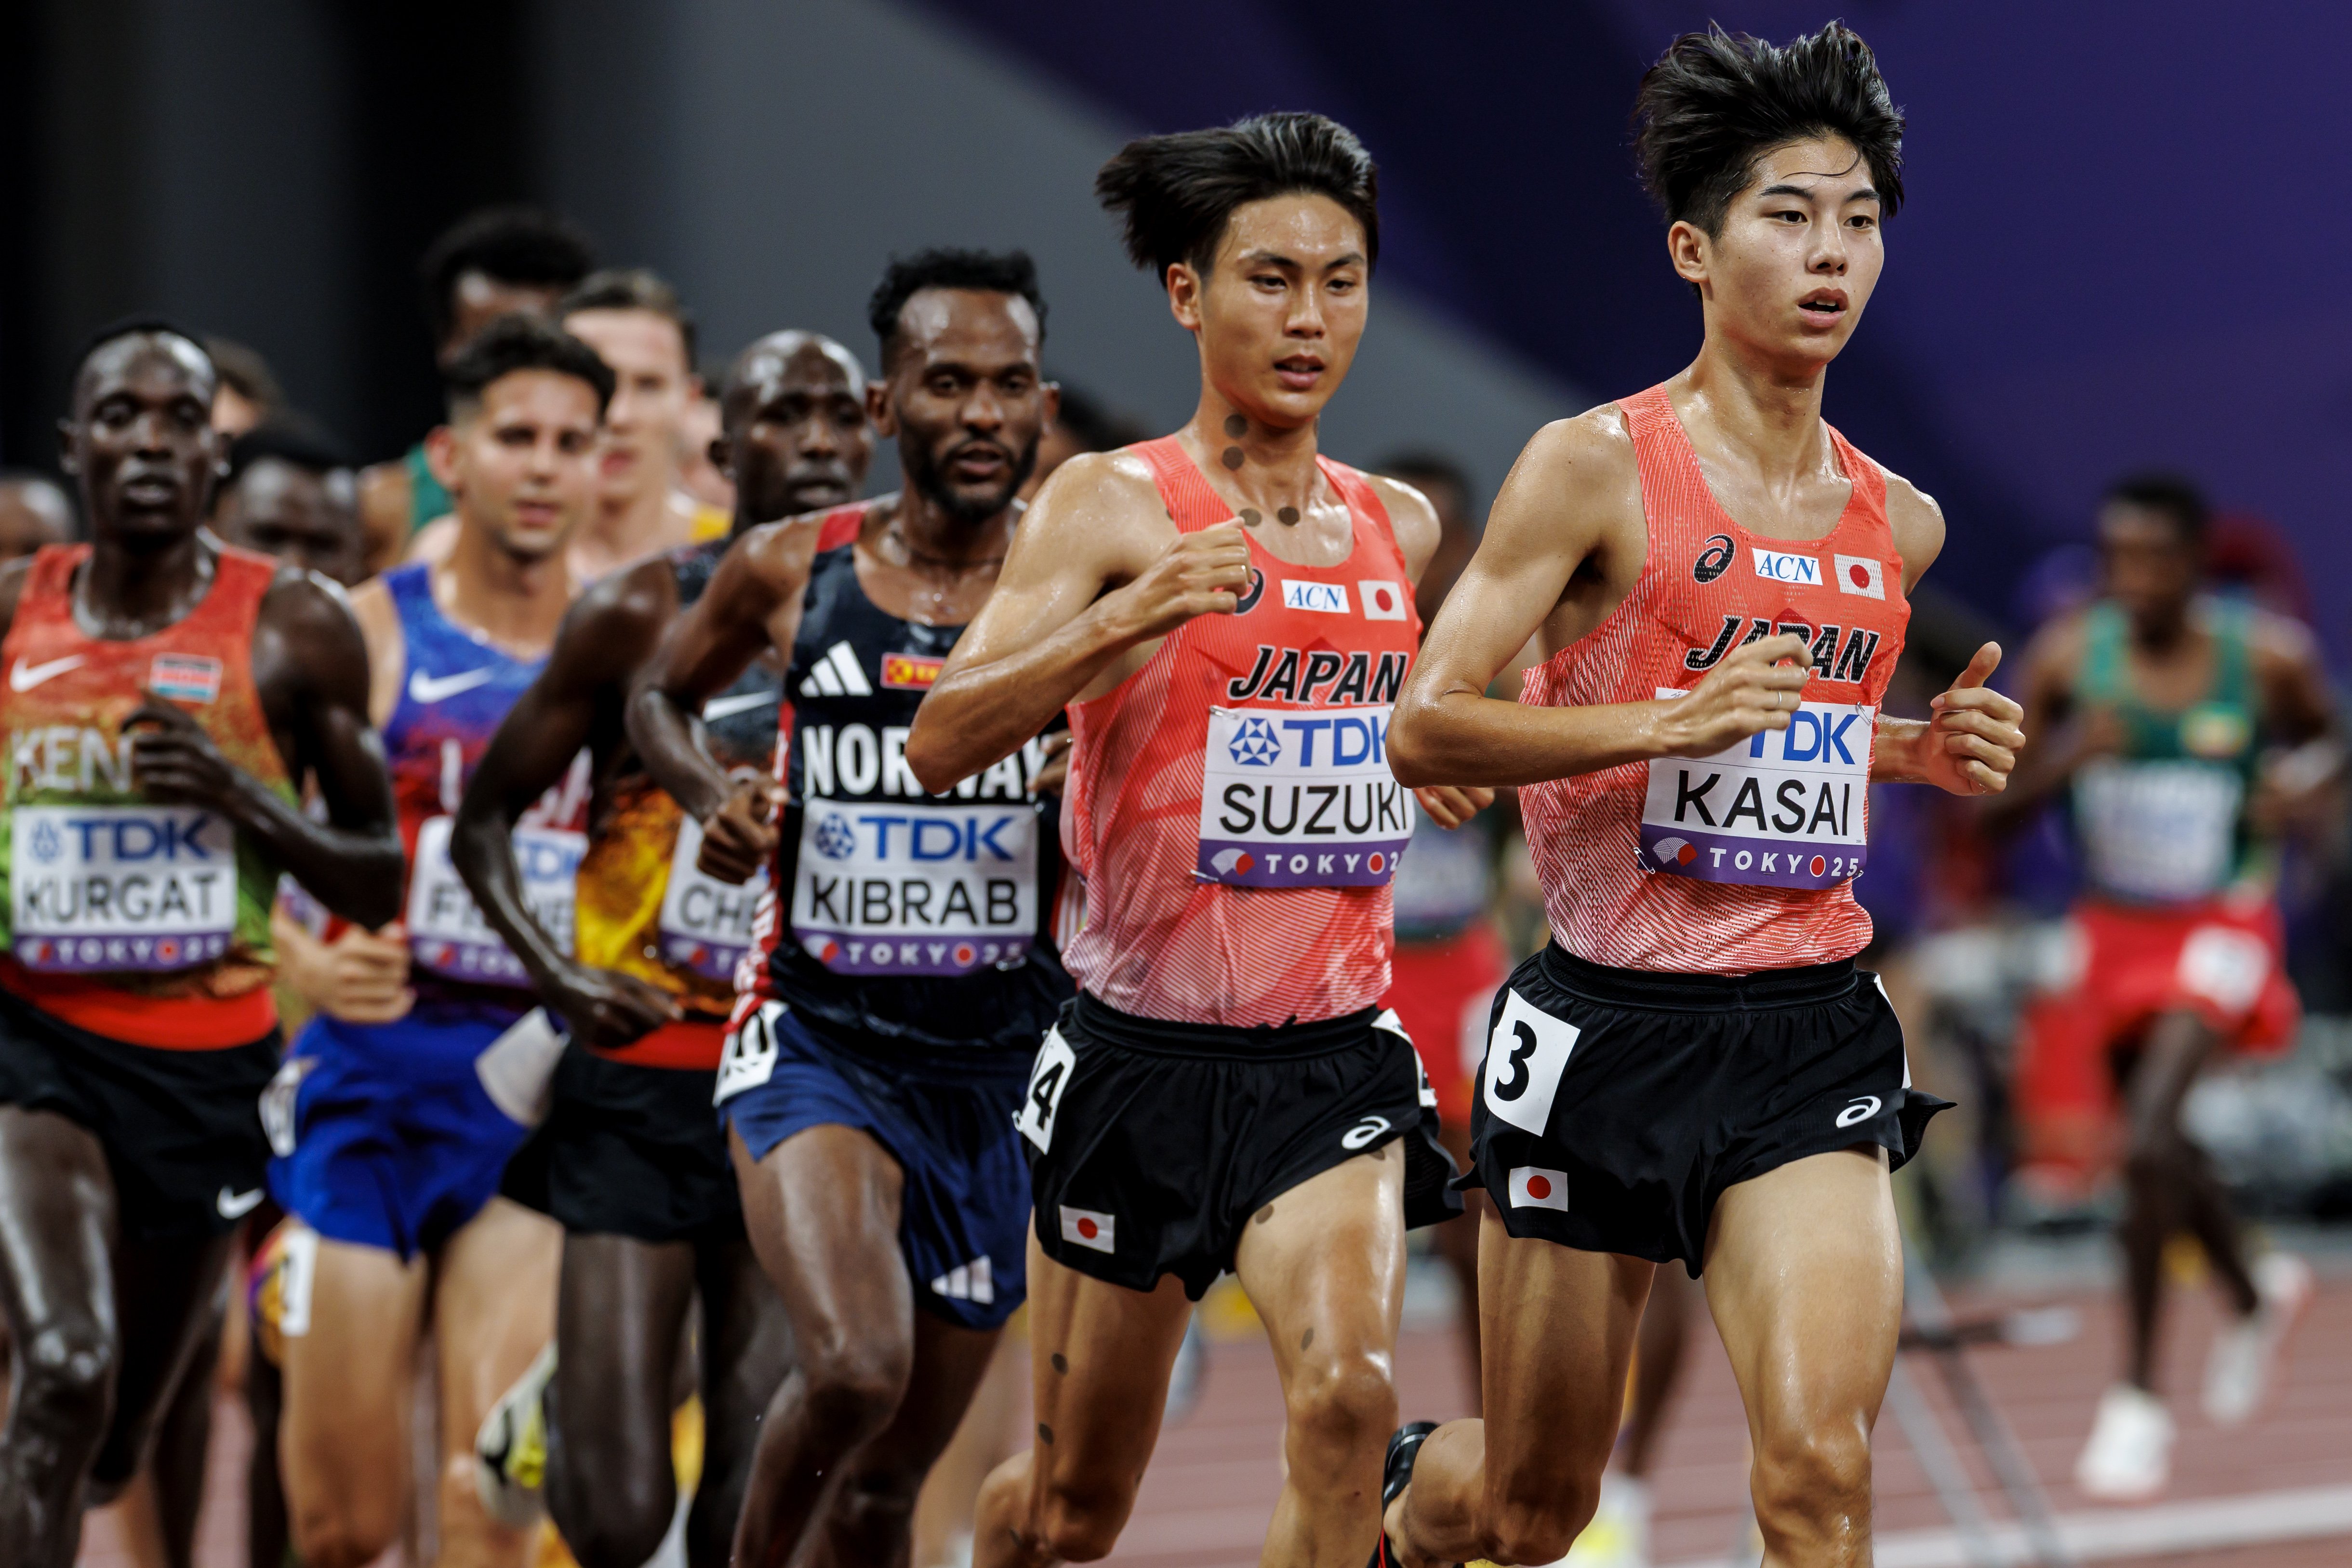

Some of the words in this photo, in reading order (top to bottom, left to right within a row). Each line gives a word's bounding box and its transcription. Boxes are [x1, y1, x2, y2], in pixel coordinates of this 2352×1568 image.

[1757, 552, 1817, 582] ACN
[1289, 585, 1343, 609] ACN
[1228, 644, 1409, 706] JAPAN
[9, 724, 135, 794] KEN
[802, 723, 1049, 803] NORAY
[1219, 781, 1406, 836] SUZUKI
[1674, 770, 1850, 836] KASAI
[66, 817, 211, 861] TDK
[858, 814, 1016, 863] TDK
[22, 873, 218, 923] KURGAT
[811, 875, 1018, 926] KIBRAB
[1494, 1020, 1537, 1102] 3
[1032, 1060, 1065, 1132] 4
